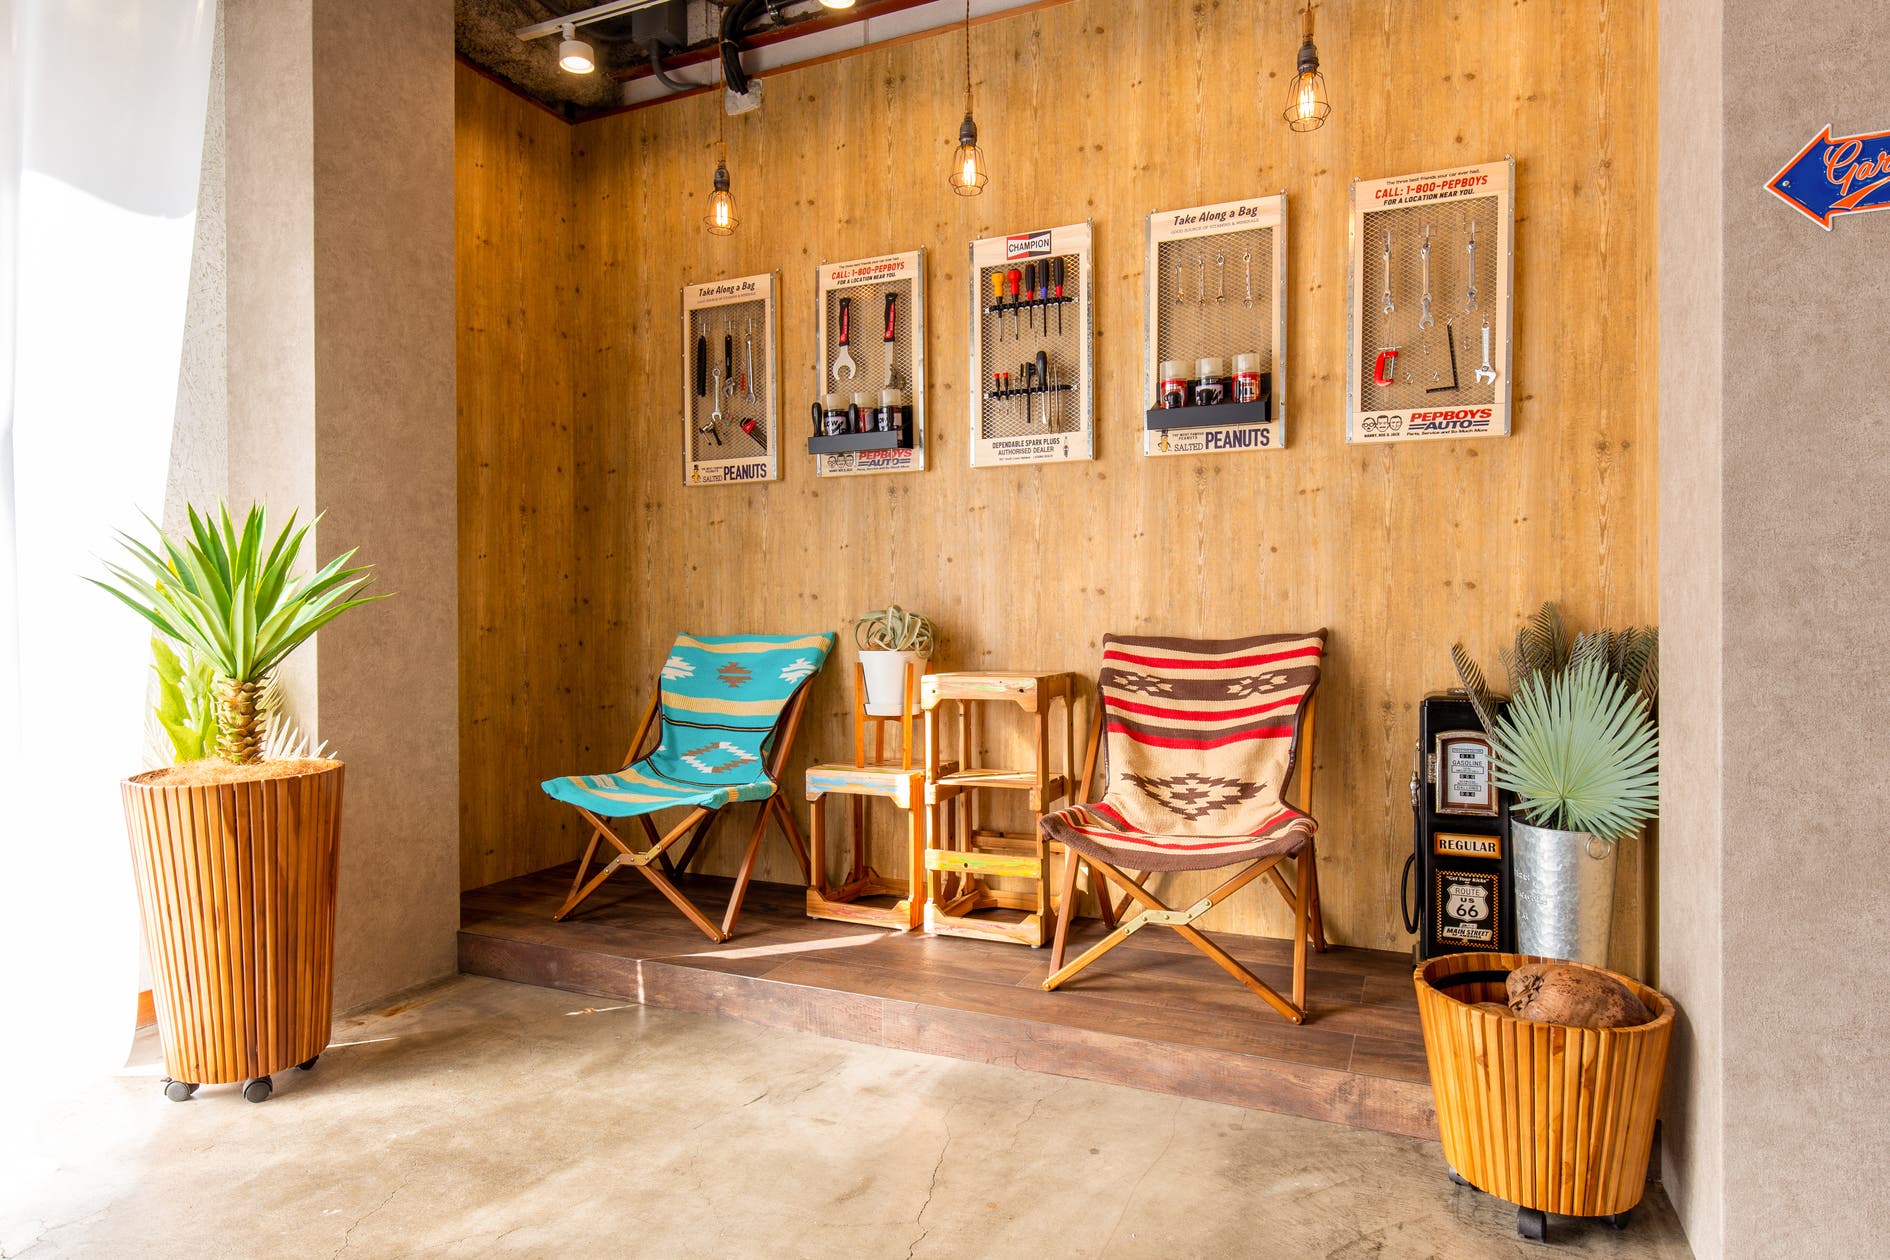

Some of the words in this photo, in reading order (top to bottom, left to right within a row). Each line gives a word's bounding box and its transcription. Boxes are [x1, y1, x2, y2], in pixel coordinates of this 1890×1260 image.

[1375, 187, 1404, 199] CALL:
[1406, 175, 1488, 194] 1-800-PEPBOYS
[1404, 193, 1438, 203] LOCATION
[1174, 214, 1197, 226] Take
[1199, 211, 1226, 222] Along
[1229, 210, 1235, 218] a
[1238, 206, 1258, 217] Bag
[1008, 239, 1049, 253] CHAMPION
[832, 271, 850, 280] CALL:
[852, 261, 905, 276] 1-800-PEPBOYS
[699, 287, 714, 296] Take
[716, 285, 734, 294] Along
[742, 282, 755, 291] Bag
[1410, 409, 1492, 422] PEPBOYS
[1424, 420, 1473, 430] AUTO
[992, 440, 1024, 449] DEPENDABLE
[1025, 438, 1042, 447] SPARK
[1043, 437, 1061, 445] PLUGS
[1174, 442, 1204, 452] SALTED
[1205, 428, 1270, 450] PEANUTS
[858, 448, 913, 460] PEPBOYS
[998, 447, 1032, 456] AUTHORISED
[868, 458, 899, 467] AUTO
[723, 463, 767, 481] PEANUTS
[1452, 759, 1483, 767] GASOLINE
[1439, 839, 1496, 852] REGULAR
[1455, 887, 1480, 896] ROUTE
[1456, 904, 1478, 918] 66
[1446, 927, 1466, 935] MAIN
[1466, 929, 1490, 937] STREET
